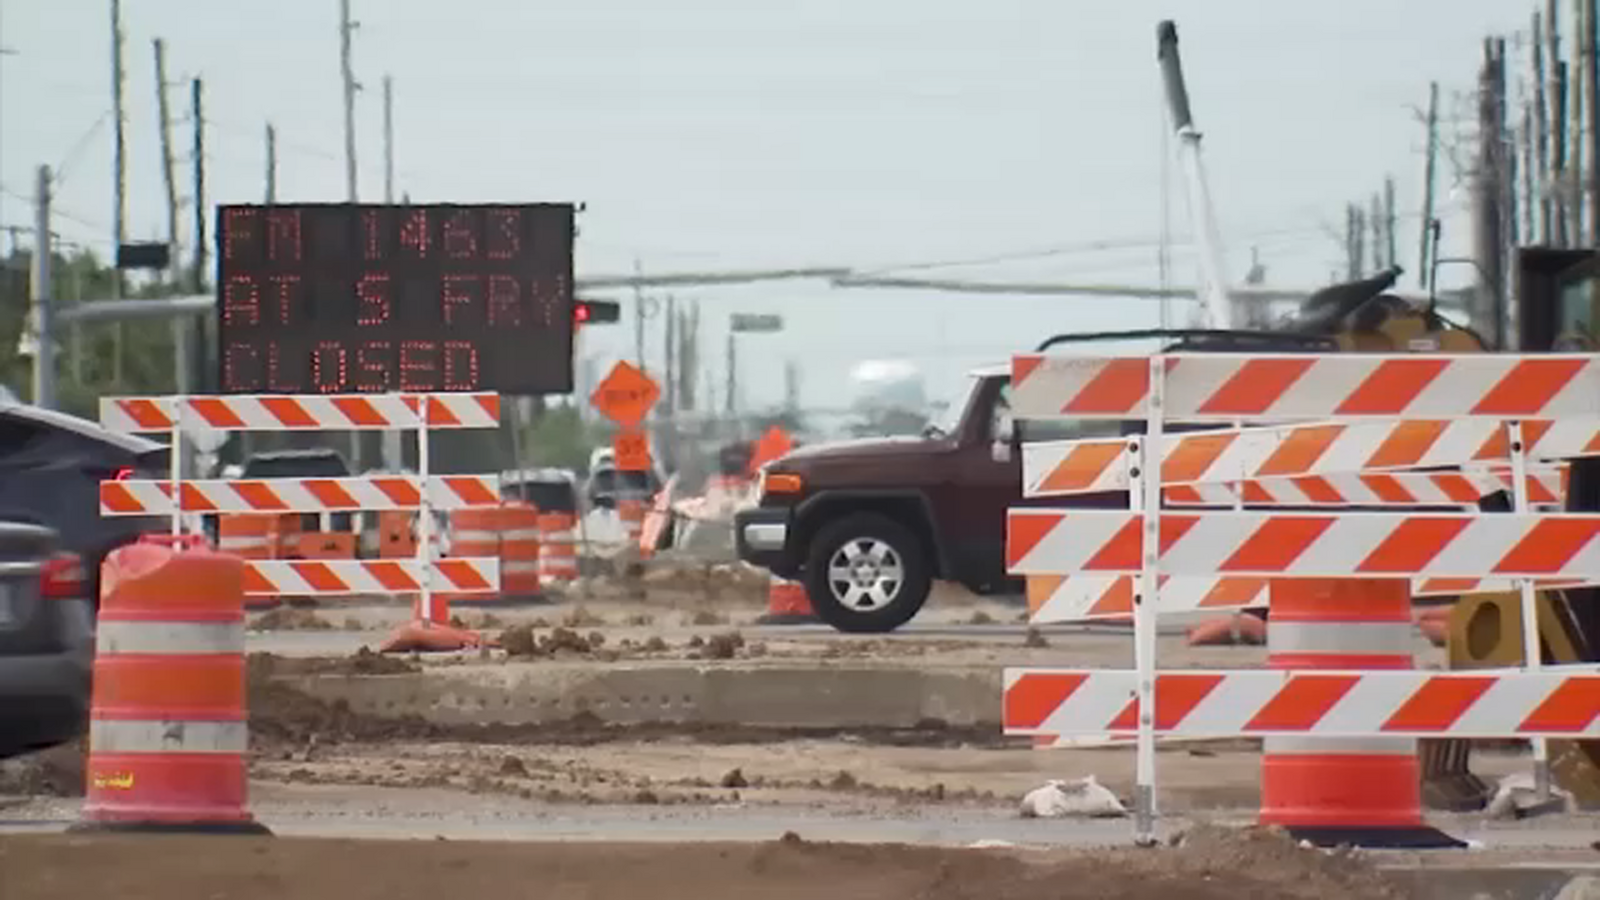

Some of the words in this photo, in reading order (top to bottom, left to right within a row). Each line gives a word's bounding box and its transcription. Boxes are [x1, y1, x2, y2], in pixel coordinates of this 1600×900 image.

[222, 208, 303, 259] FM
[363, 208, 522, 259] 1463
[223, 274, 302, 326] AT
[354, 273, 390, 326] S
[442, 273, 566, 326] FRY
[223, 340, 479, 392] CLOSED
